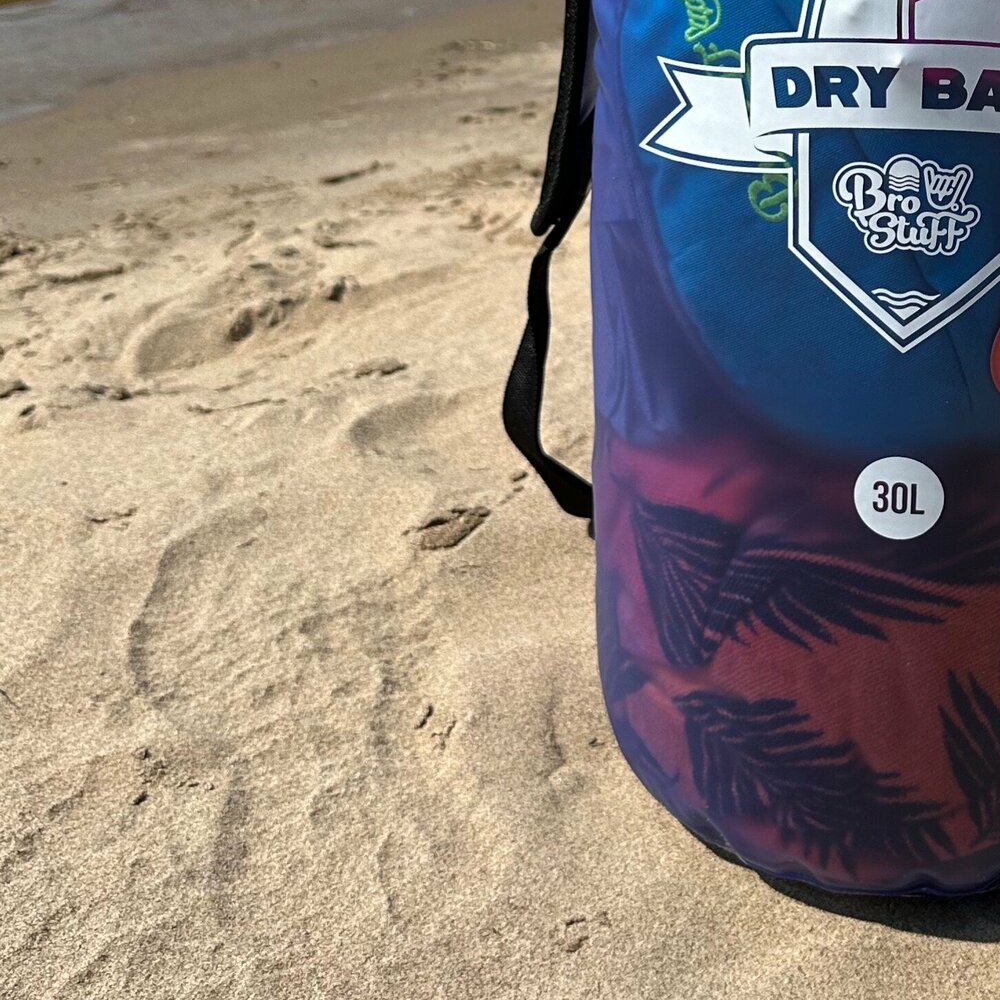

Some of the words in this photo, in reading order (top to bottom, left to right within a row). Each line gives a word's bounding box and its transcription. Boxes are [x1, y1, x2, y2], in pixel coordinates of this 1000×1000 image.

[771, 66, 900, 108] DRY
[838, 168, 921, 227] Bro
[868, 211, 974, 249] Stuff
[872, 480, 925, 515] 30L
